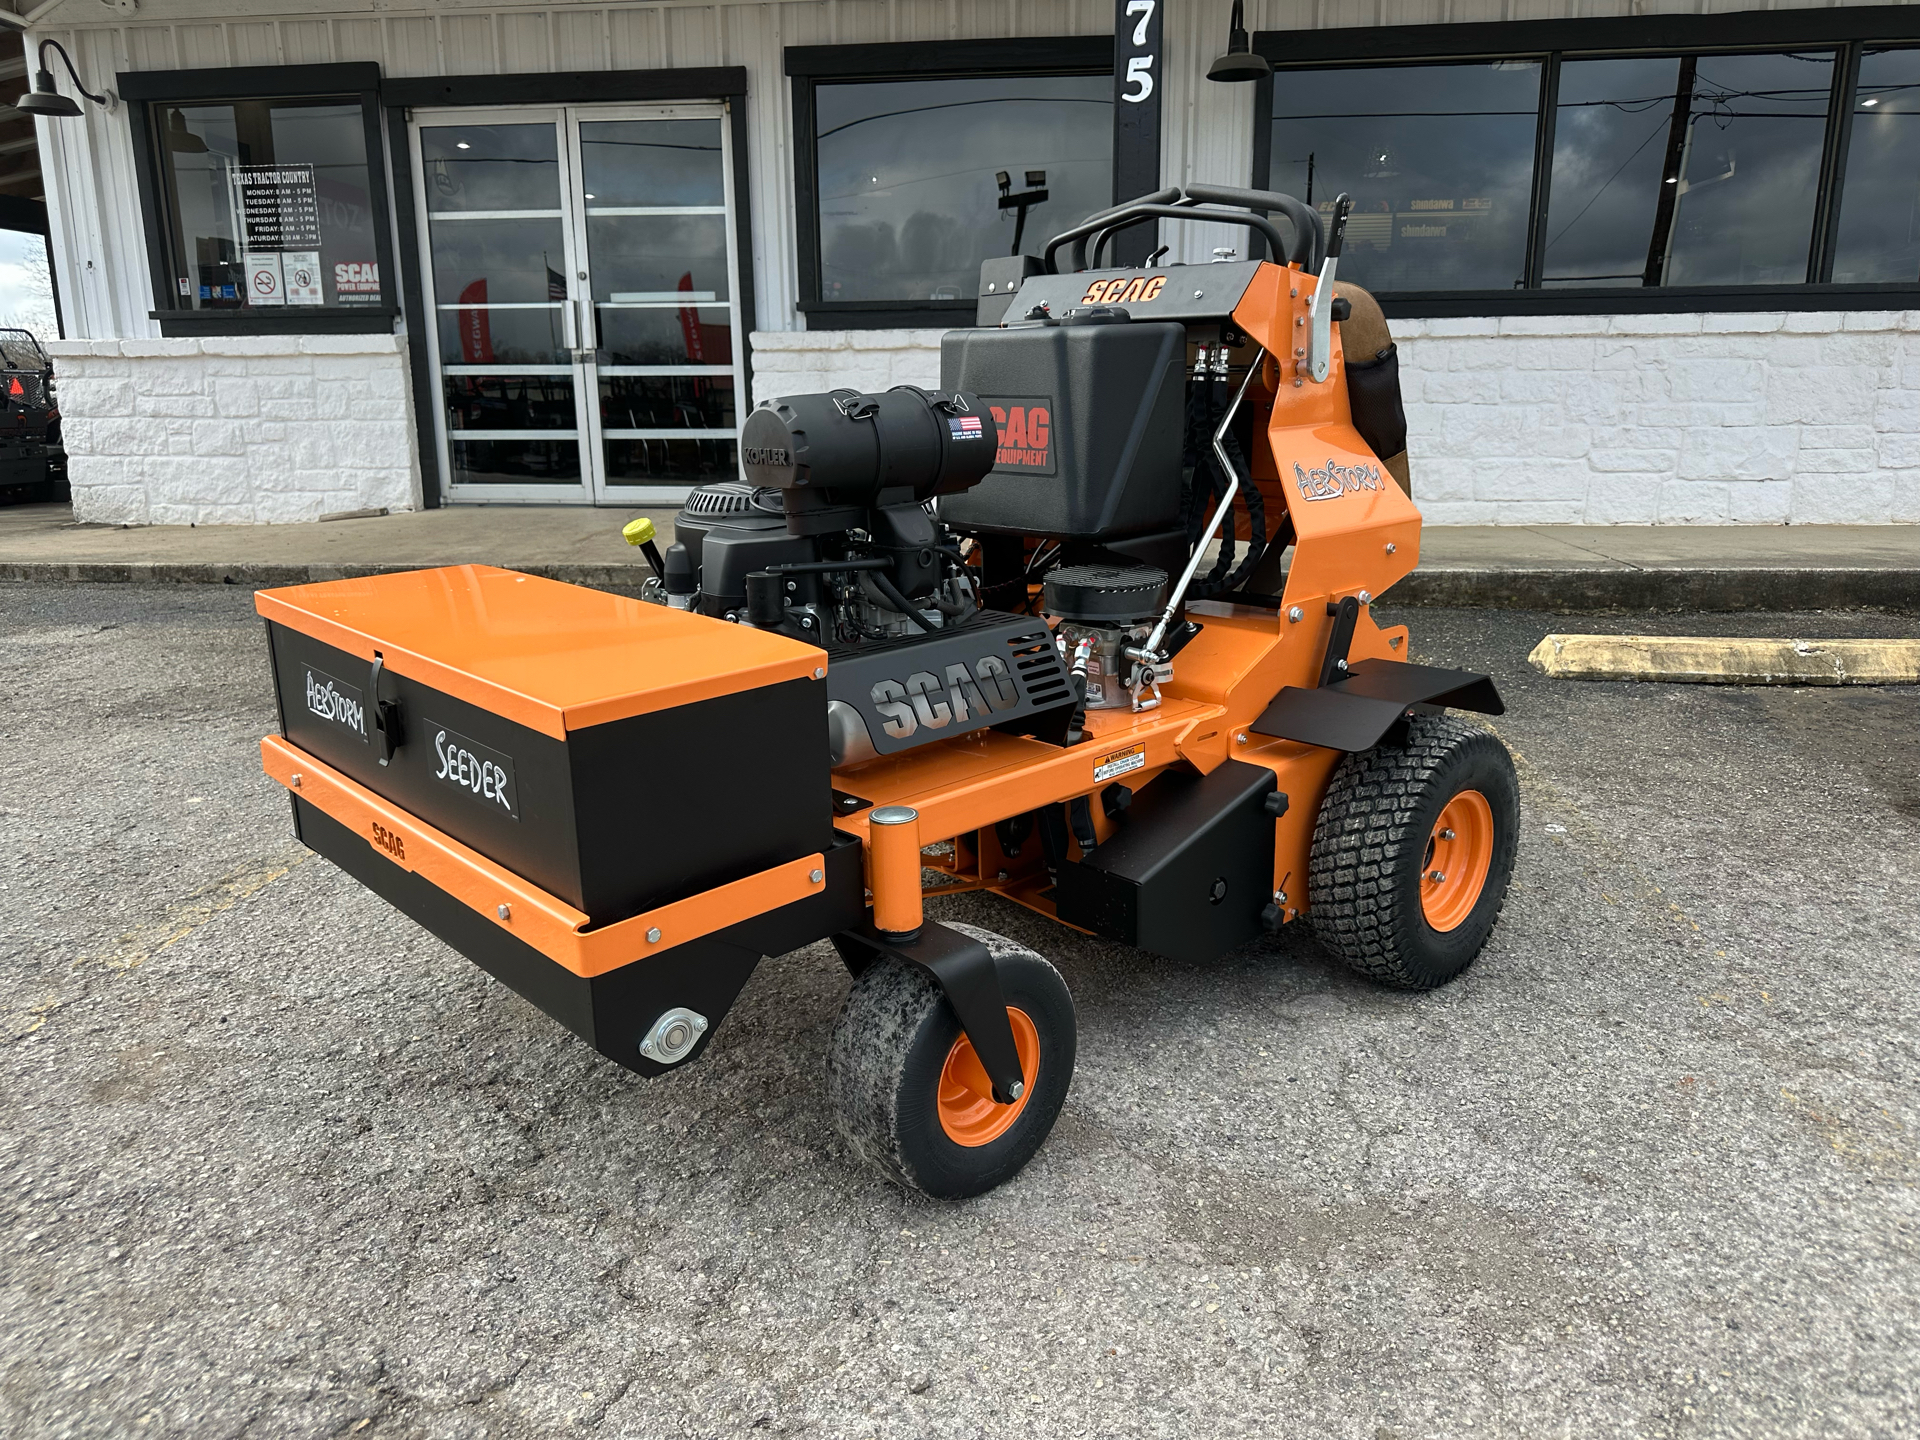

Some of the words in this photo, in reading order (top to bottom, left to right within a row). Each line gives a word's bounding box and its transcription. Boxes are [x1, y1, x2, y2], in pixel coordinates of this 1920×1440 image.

[232, 172, 253, 185] TEXAS
[253, 171, 281, 185] TRACTOR
[281, 171, 310, 184] COUNTRY
[1410, 199, 1454, 210] shindaiwa
[1401, 224, 1447, 238] shindaiwa
[336, 283, 356, 291] POWER
[356, 283, 380, 291] EQUIPME
[1081, 275, 1168, 305] SCAG
[470, 301, 484, 360] SEGWA
[990, 406, 1049, 449] CAG
[995, 448, 1048, 466] EQUIPMENT
[870, 654, 1020, 739] SCAG
[1110, 748, 1135, 760] WARNING
[372, 821, 406, 862] SCAG
